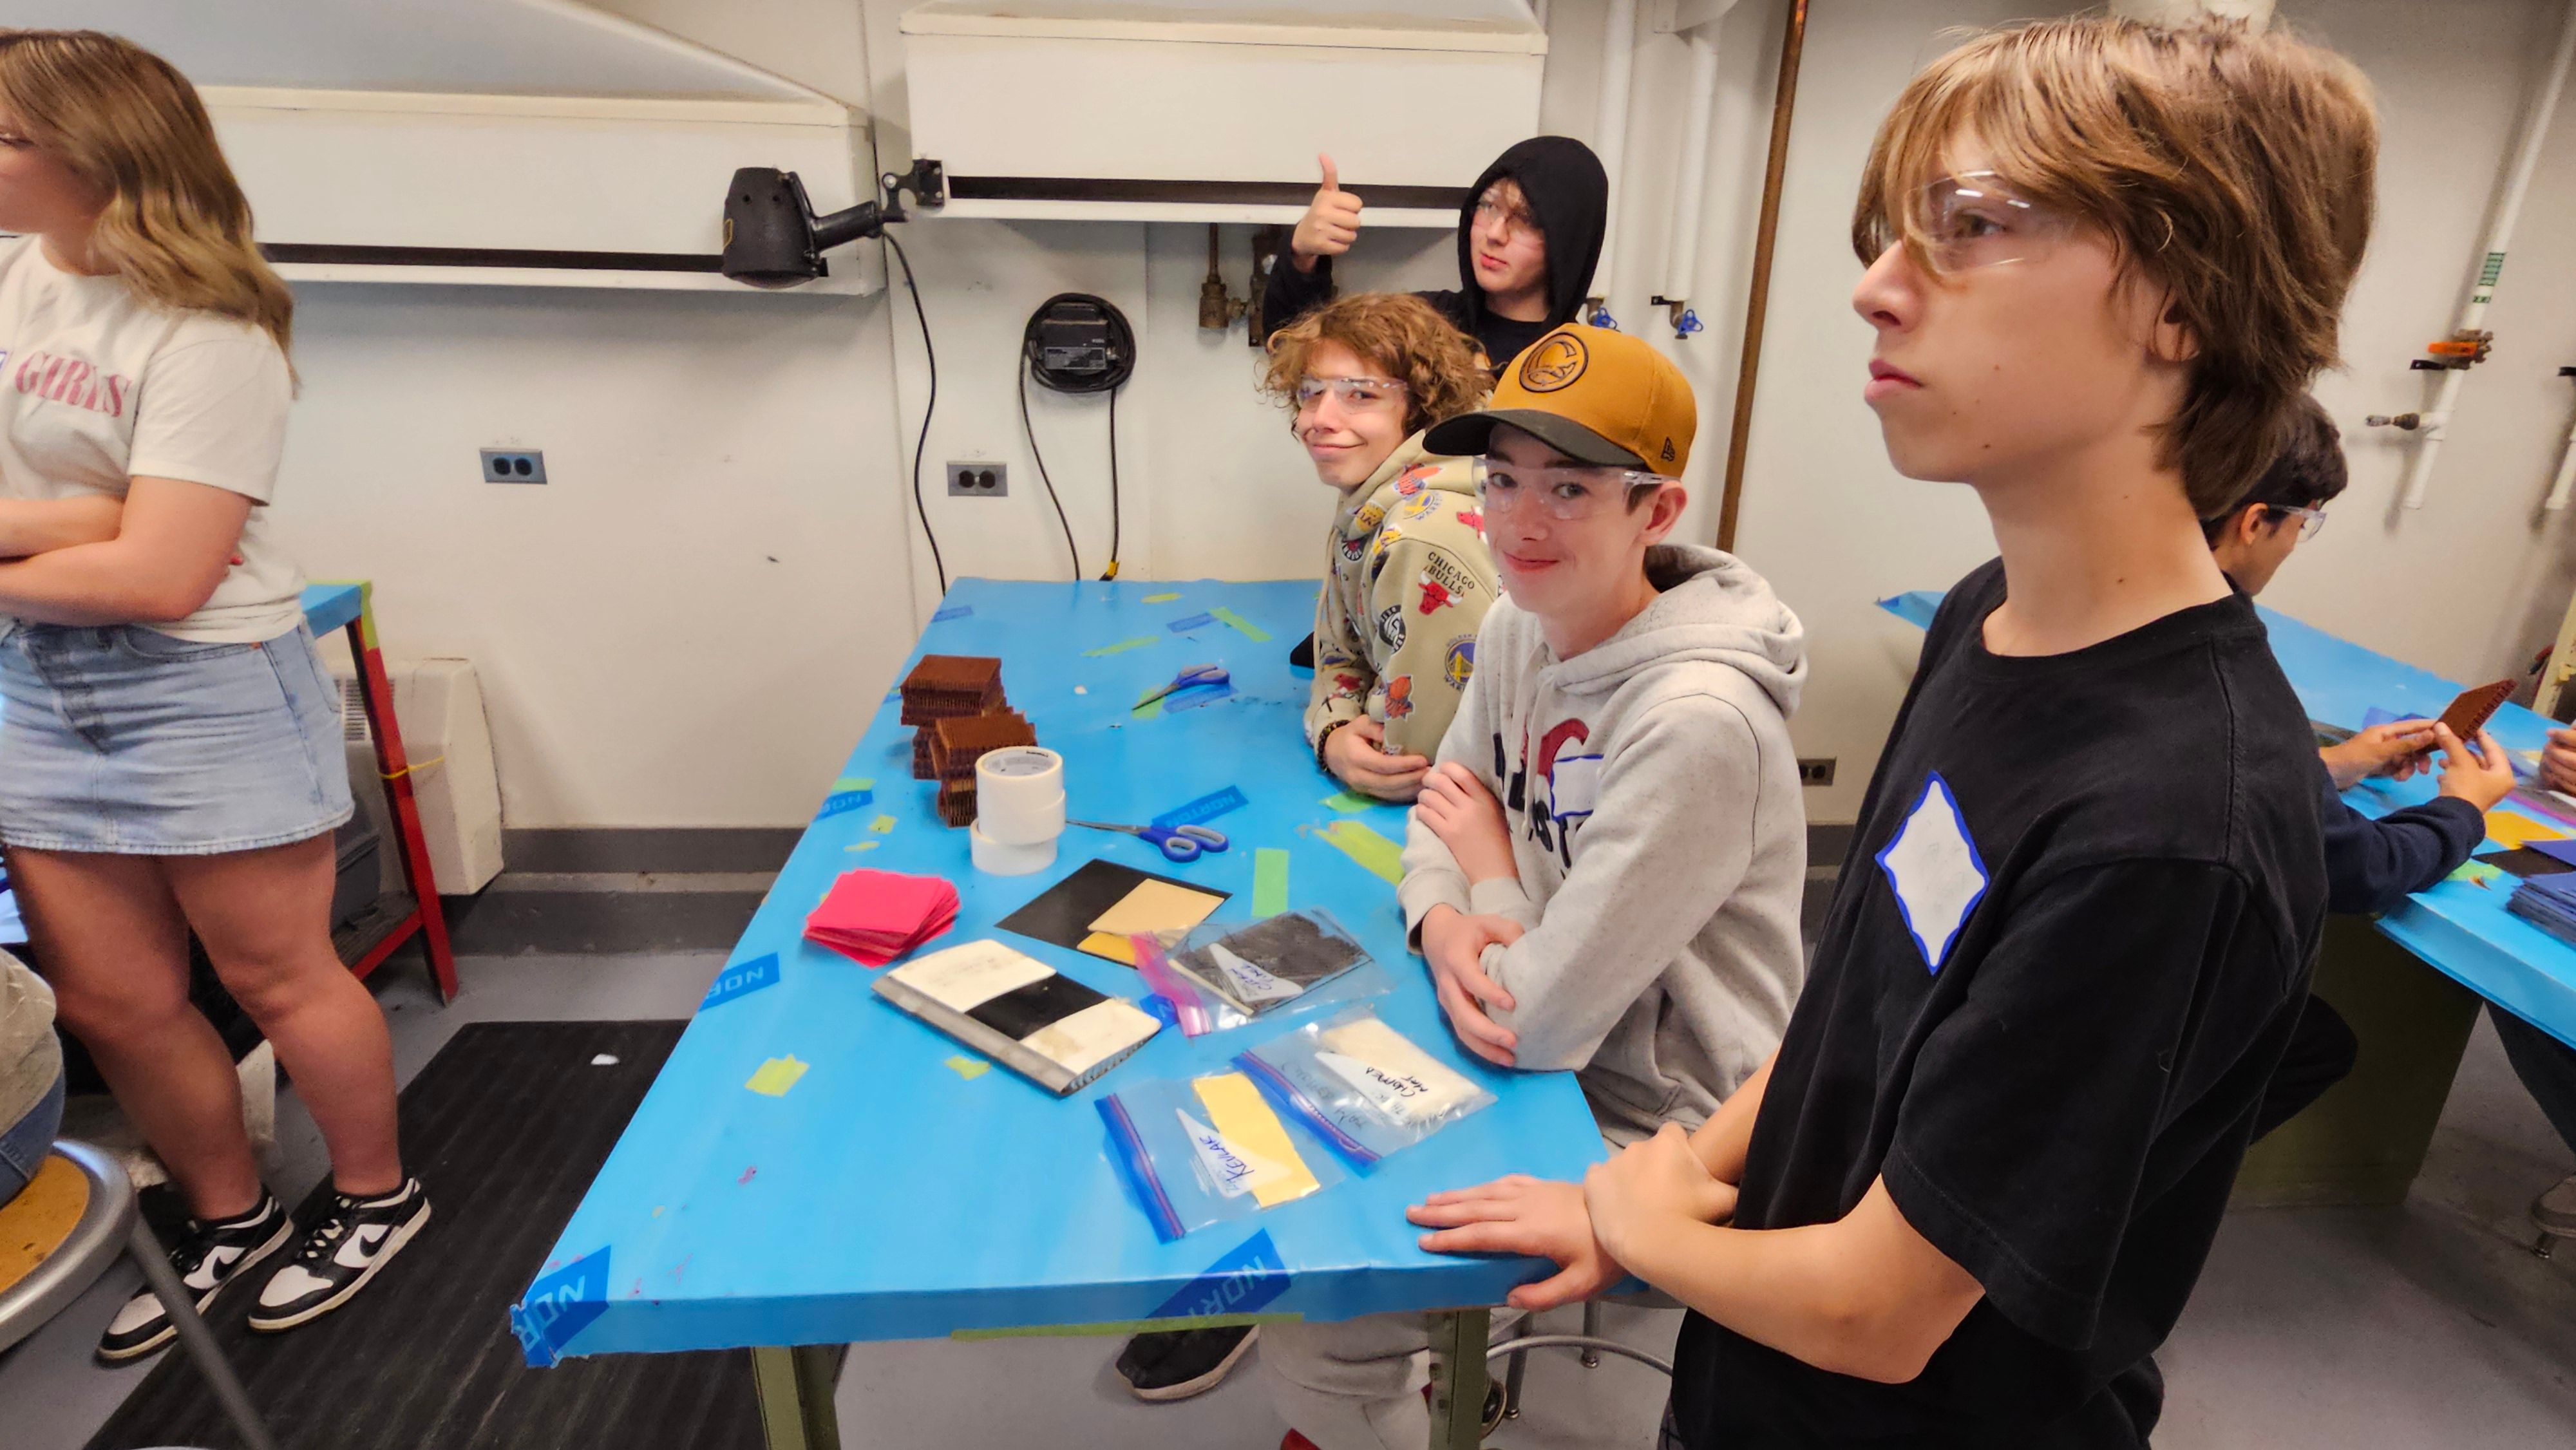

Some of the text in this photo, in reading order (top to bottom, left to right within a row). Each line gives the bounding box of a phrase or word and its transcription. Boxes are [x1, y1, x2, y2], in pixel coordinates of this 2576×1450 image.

[15, 352, 131, 417] GIRLS
[1428, 552, 1475, 589] CHICAGO
[1428, 565, 1463, 594] BULLS
[1165, 794, 1236, 828] NORTON
